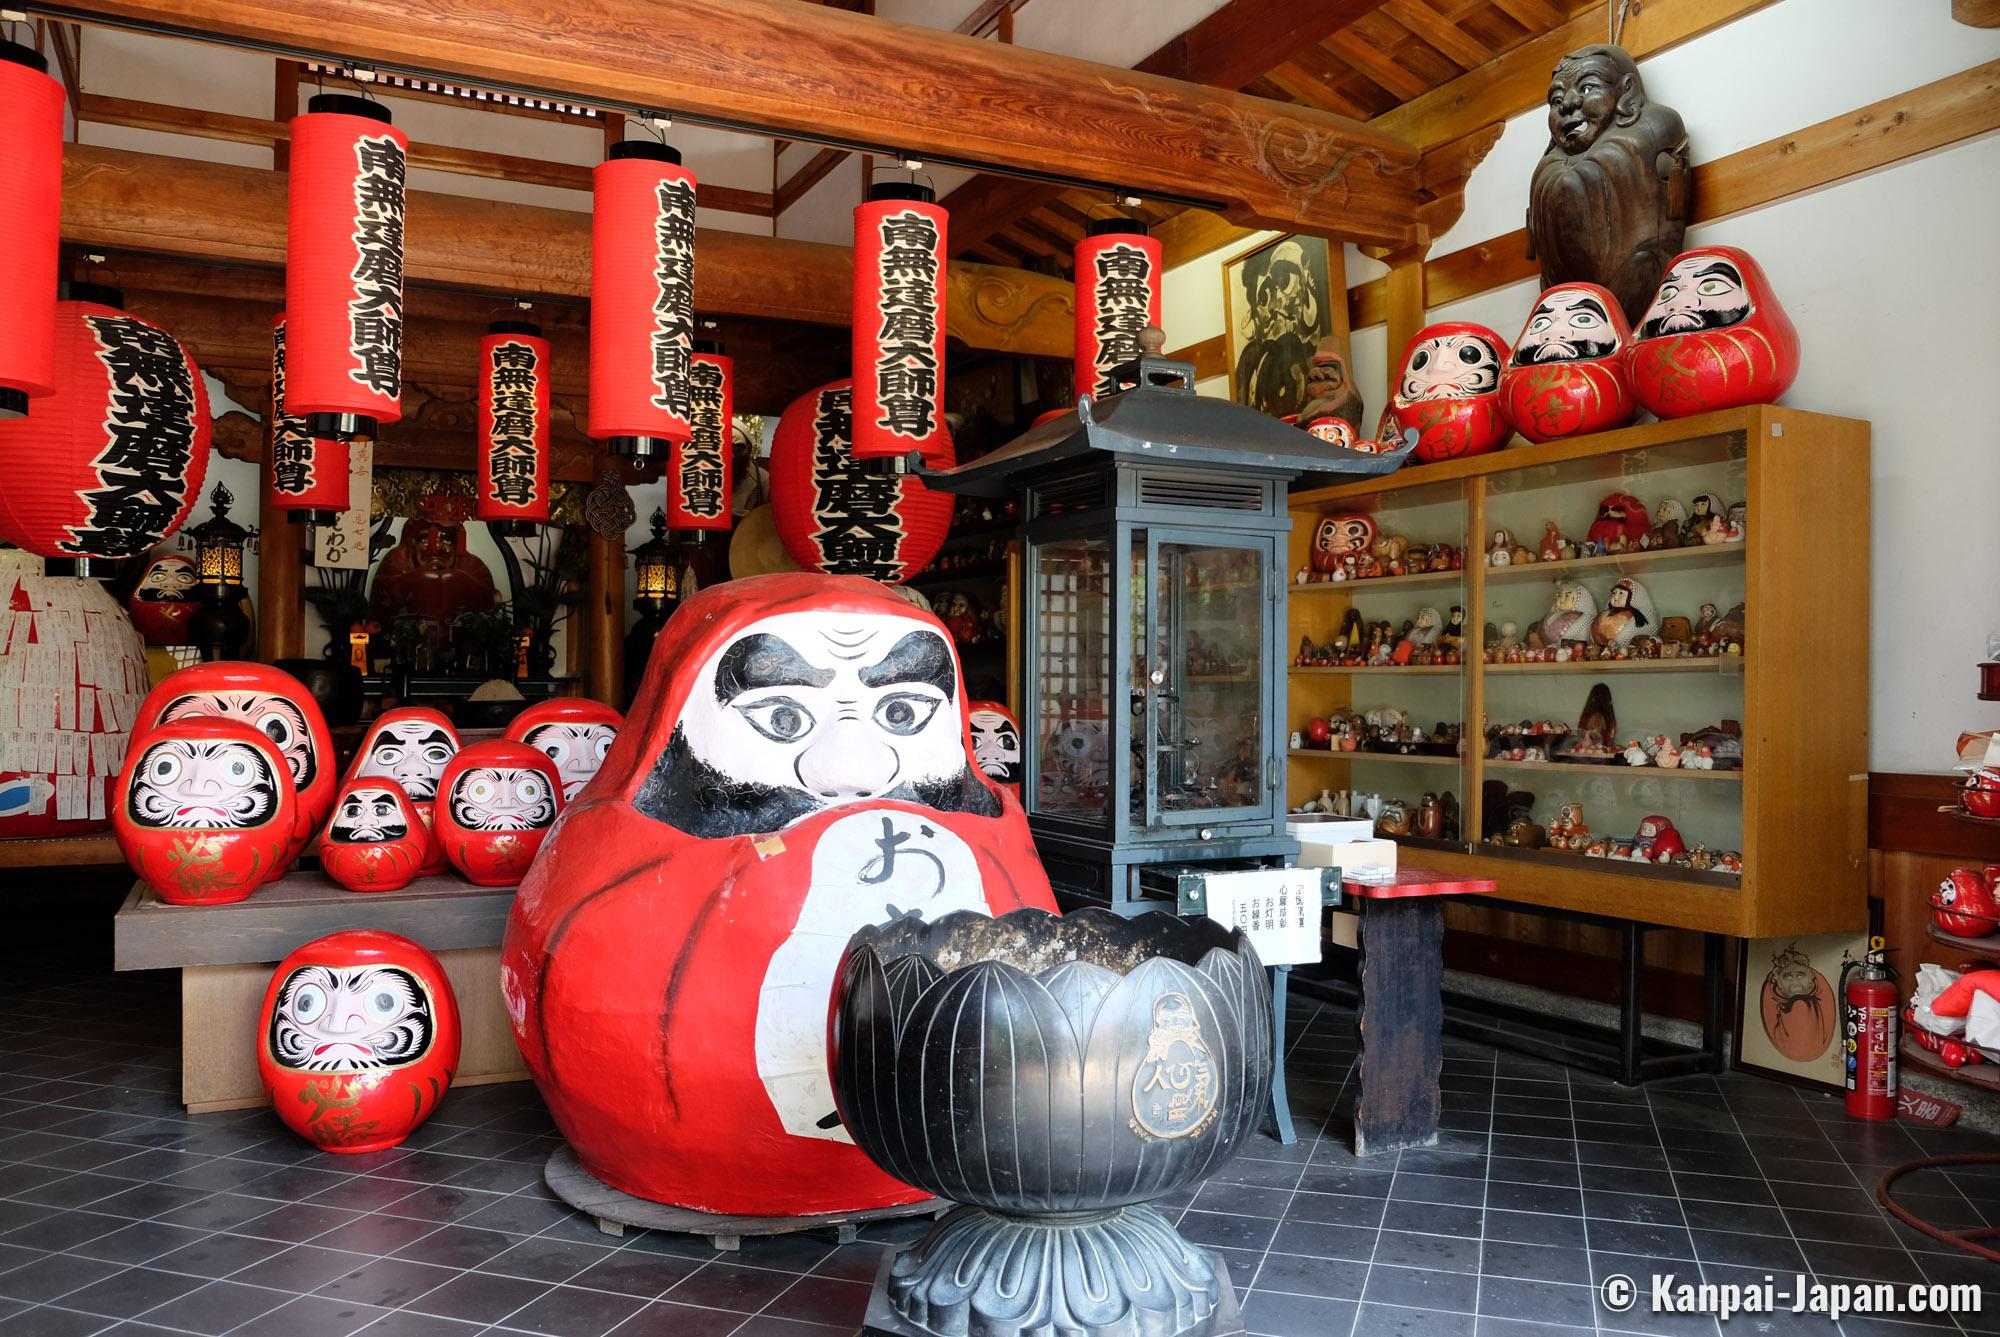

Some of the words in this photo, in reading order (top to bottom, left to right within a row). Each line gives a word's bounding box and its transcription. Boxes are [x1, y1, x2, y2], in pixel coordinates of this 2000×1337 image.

[878, 209, 940, 440] 南無達磨大師尊
[489, 340, 539, 508] 南無達磨大師尊
[1858, 1006, 1867, 1033] YP-10
